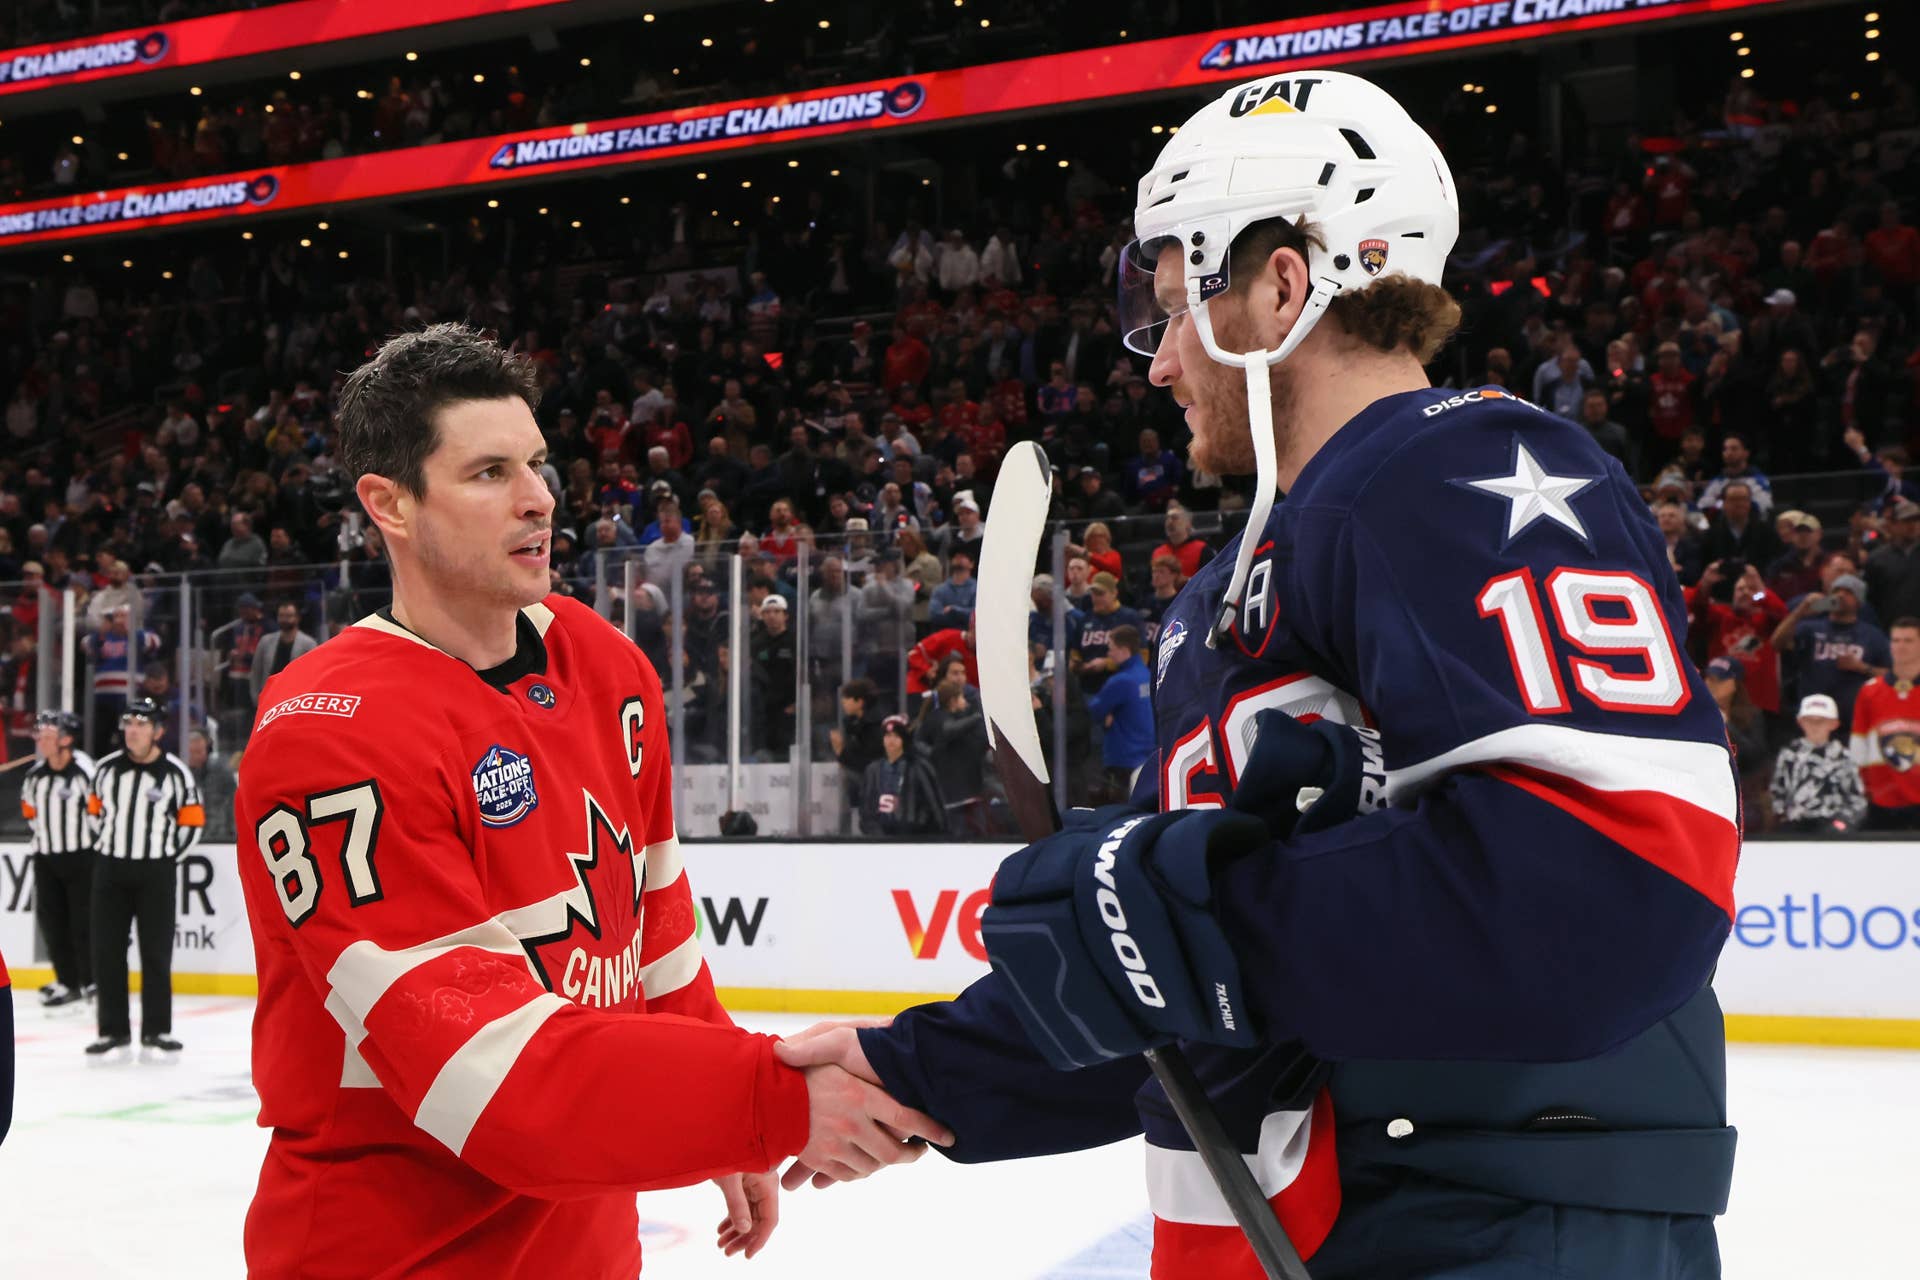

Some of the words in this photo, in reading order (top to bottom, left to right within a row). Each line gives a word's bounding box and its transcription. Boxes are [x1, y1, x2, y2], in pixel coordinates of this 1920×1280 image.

[12, 39, 137, 81] CHAMPIONS
[1235, 23, 1364, 63] NATIONS
[1229, 78, 1323, 118] CAT
[515, 130, 615, 163] NATIONS
[725, 90, 884, 134] CHAMPIONS
[122, 181, 248, 218] CHAMPIONS
[1243, 558, 1273, 635] A
[1475, 566, 1692, 715] 19
[277, 696, 354, 715] ROGERS
[619, 695, 644, 779] C
[256, 778, 385, 930] 87
[175, 924, 216, 950] ink
[1215, 982, 1236, 1031] TKACHUK
